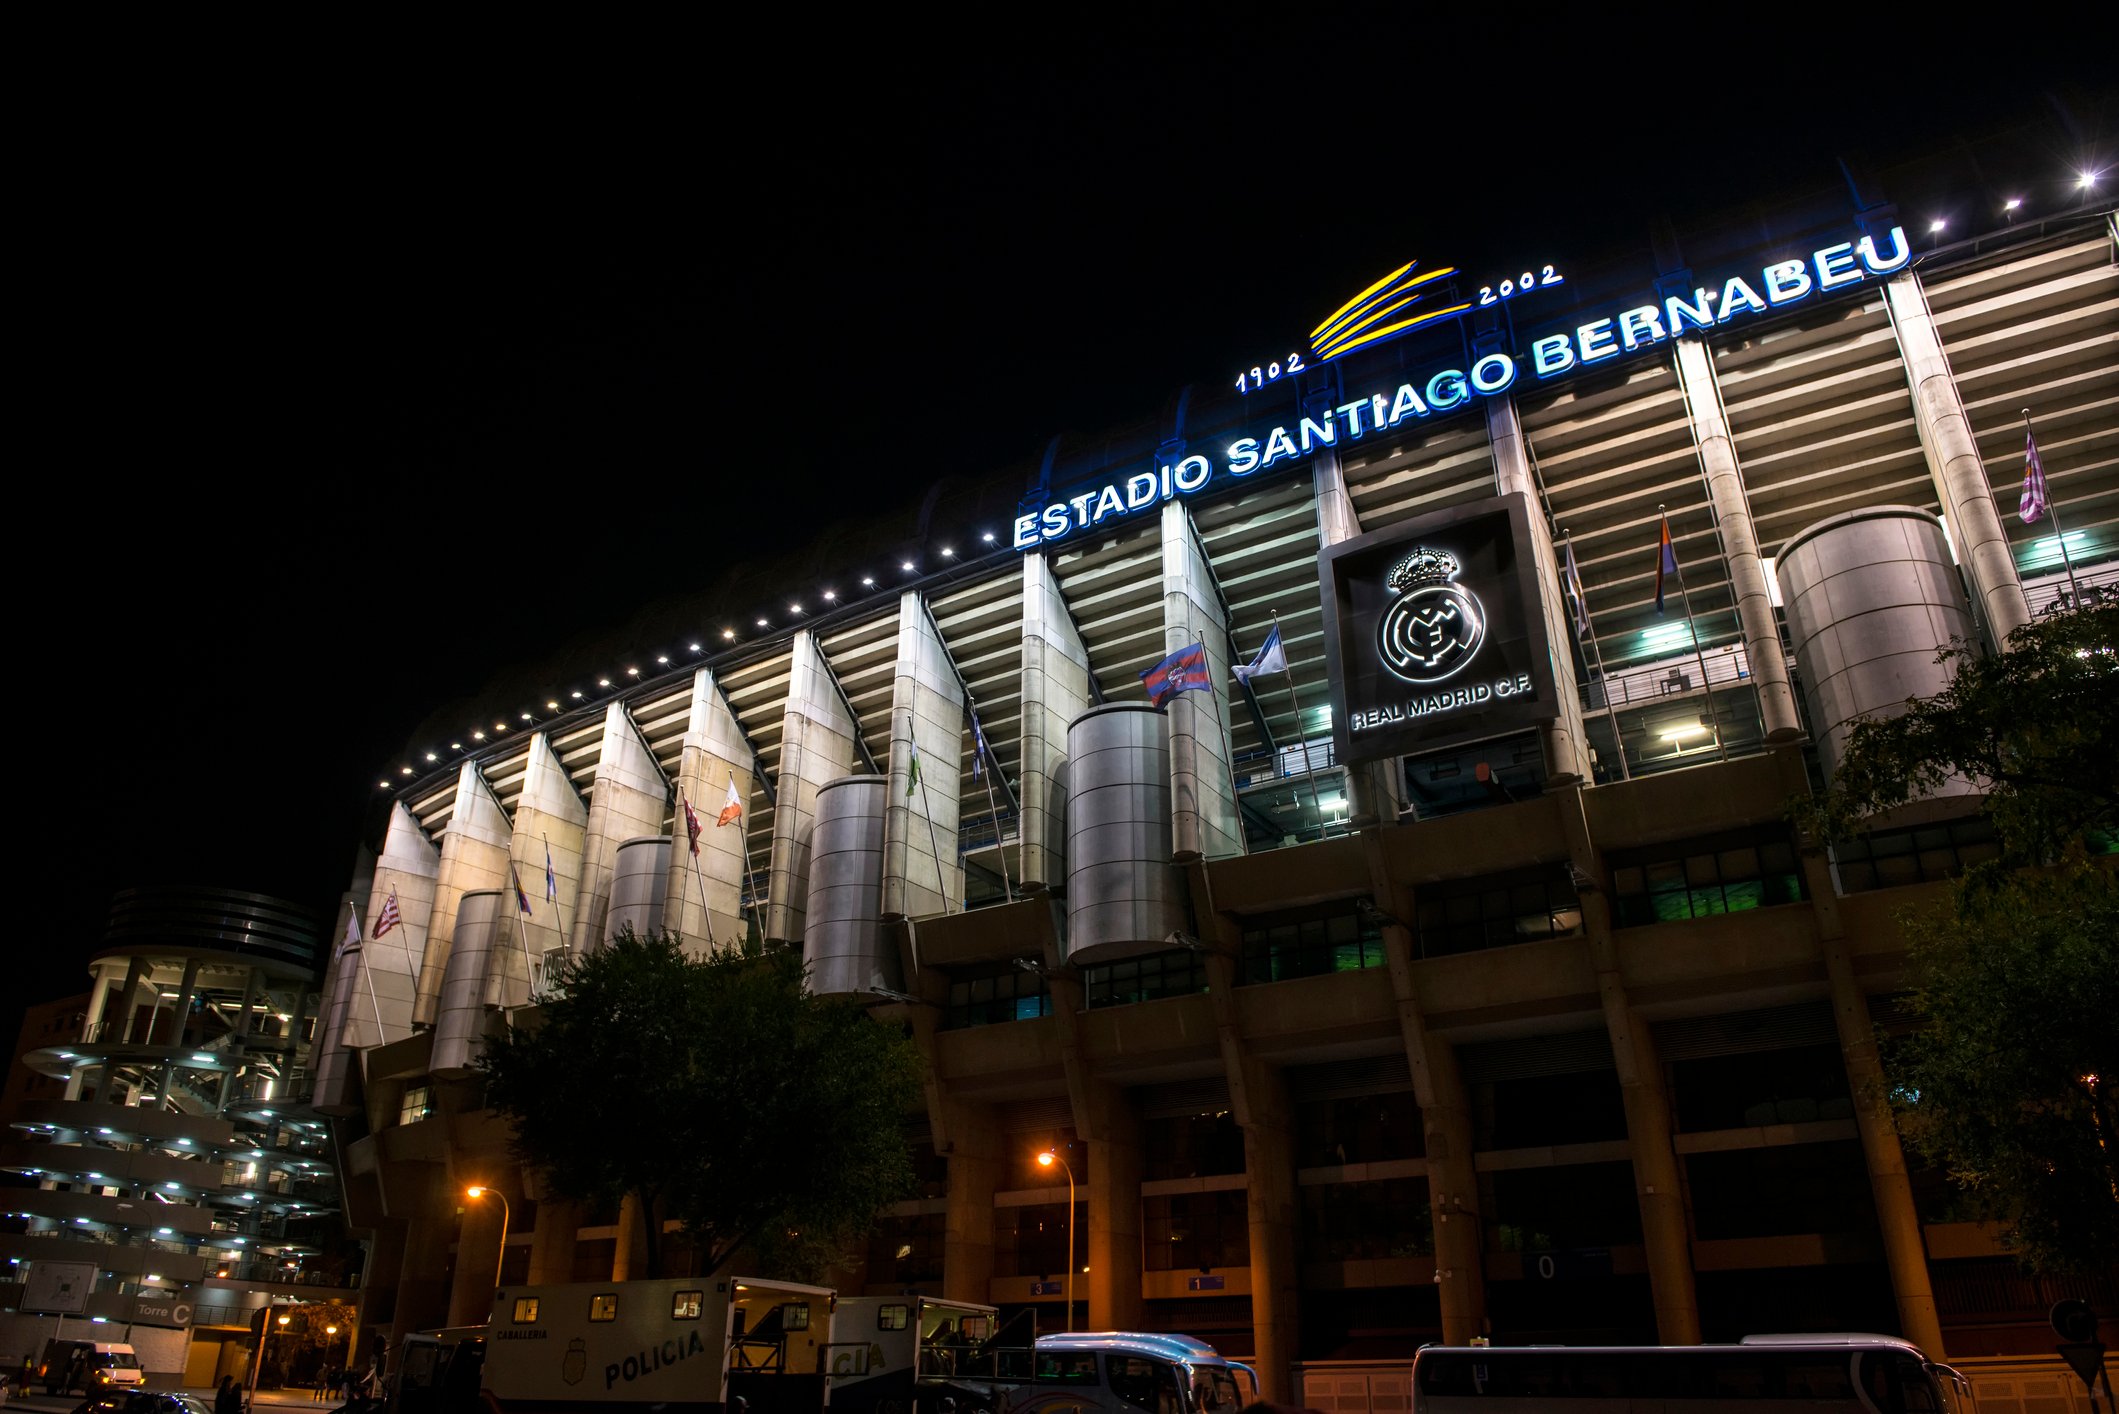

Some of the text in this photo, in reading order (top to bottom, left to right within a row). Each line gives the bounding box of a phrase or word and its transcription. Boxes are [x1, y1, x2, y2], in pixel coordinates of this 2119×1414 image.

[1479, 264, 1563, 305] 2002
[1013, 226, 1912, 550] ESTADIO SANTIAGO BERNABEU
[1235, 352, 1305, 394] 1902
[1351, 673, 1533, 730] REAL MADRID C.F.
[1194, 1278, 1201, 1290] 1
[1538, 1254, 1556, 1280] 0
[1034, 1282, 1044, 1295] 3
[138, 1303, 191, 1325] Torre C
[496, 1329, 548, 1341] CABALLERIA
[605, 1329, 705, 1390] POLICIA
[832, 1343, 886, 1379] CIA
